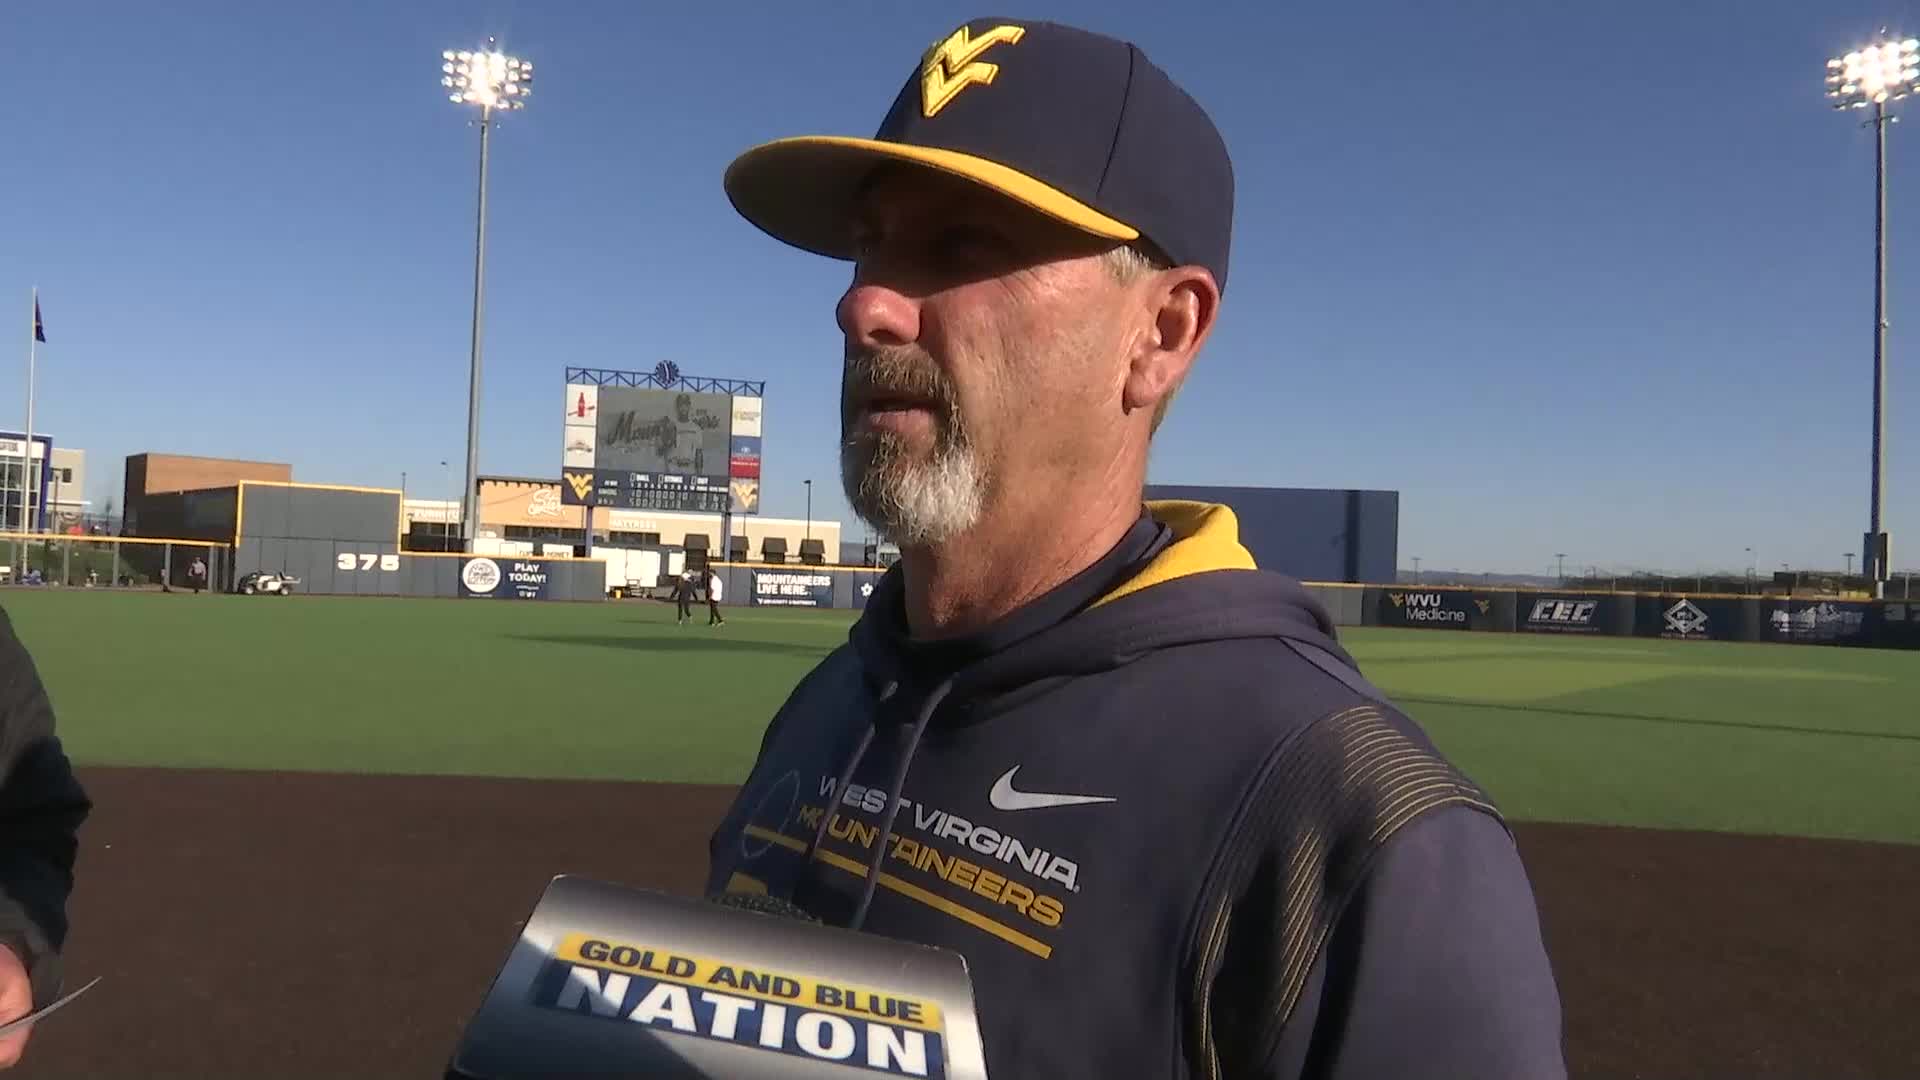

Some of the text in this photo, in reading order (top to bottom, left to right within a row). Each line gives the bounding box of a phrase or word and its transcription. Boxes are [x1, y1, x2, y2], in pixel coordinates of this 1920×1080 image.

[337, 553, 399, 571] 375
[514, 563, 540, 573] PLAY
[508, 573, 547, 583] TODAY!
[757, 574, 831, 586] MOUNTAINEERS
[757, 584, 778, 595] LIVE
[1405, 593, 1441, 607] WVU
[1406, 606, 1465, 622] Medicine
[799, 804, 1063, 927] MUNAINEERS
[578, 939, 923, 1024] GOLD AND BLUE
[555, 965, 932, 1077] NATION
